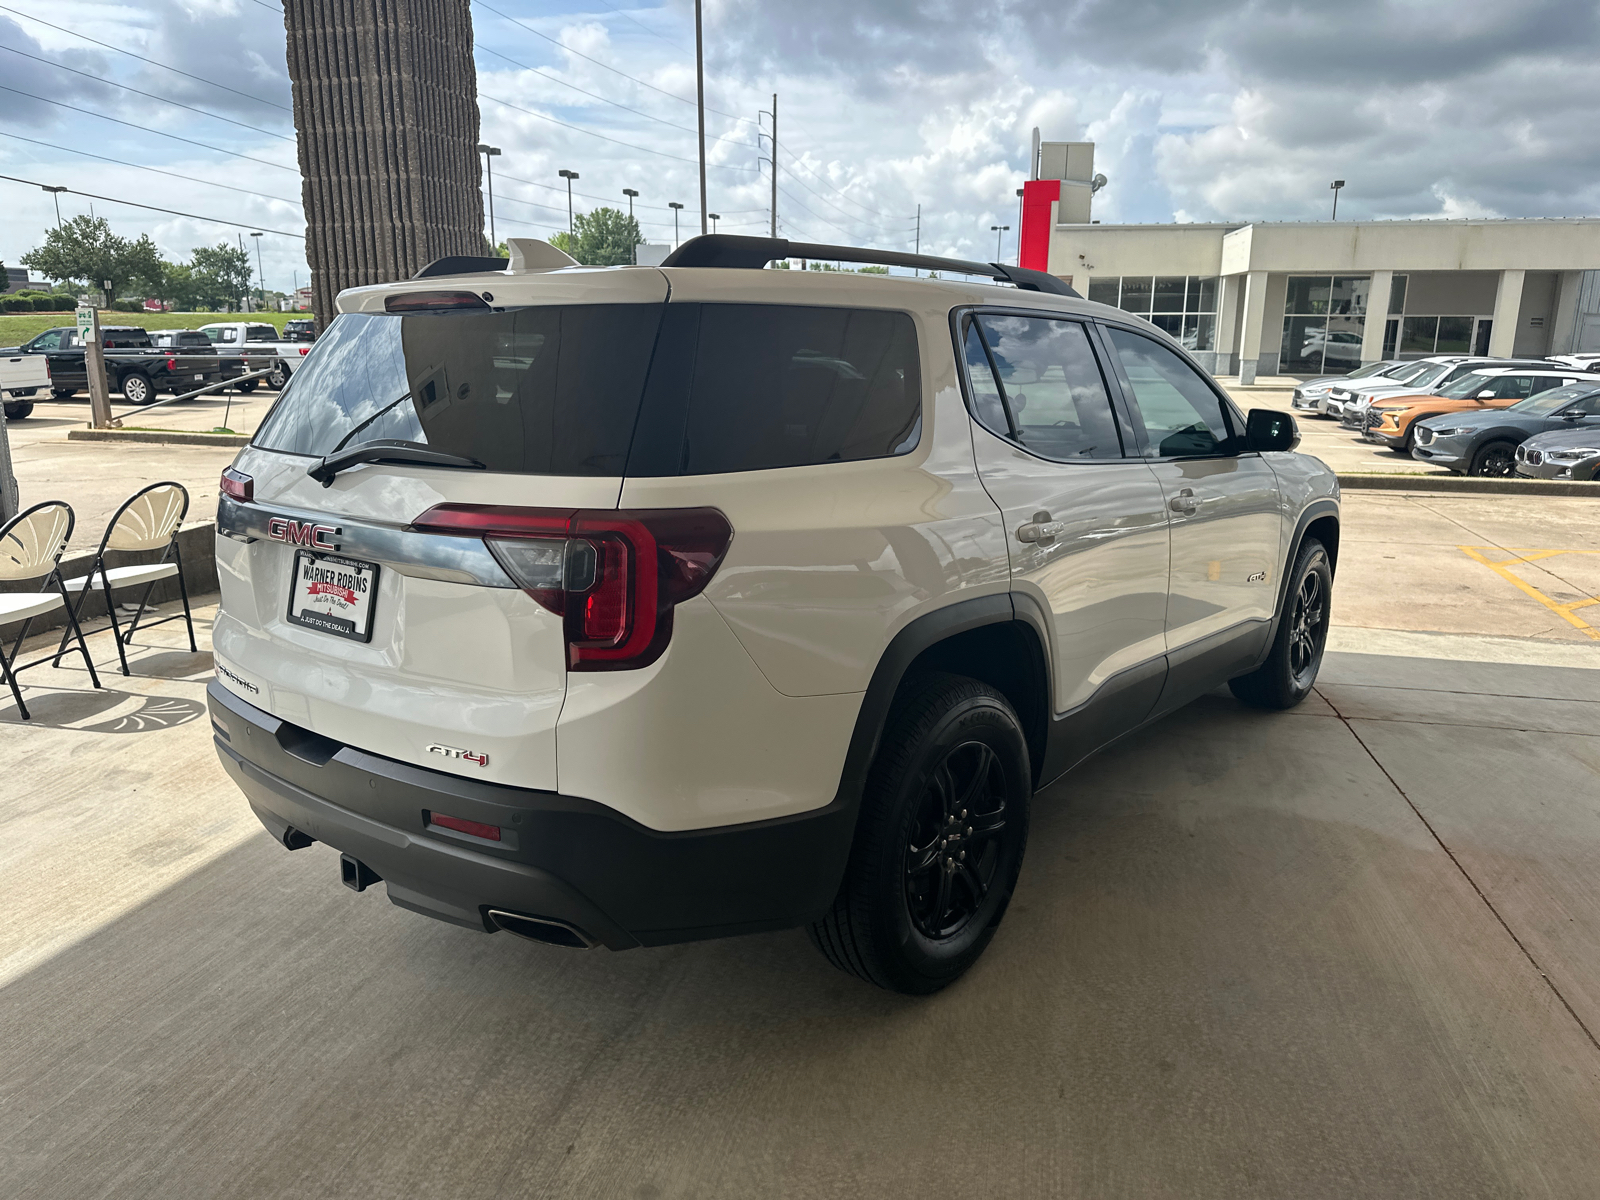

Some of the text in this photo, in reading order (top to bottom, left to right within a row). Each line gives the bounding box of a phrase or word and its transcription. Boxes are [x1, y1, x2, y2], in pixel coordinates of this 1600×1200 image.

[268, 517, 341, 551] GMC
[303, 564, 368, 594] WARNER ROBINS
[316, 583, 349, 599] MITSUBISHI
[304, 616, 316, 625] JUST
[322, 620, 332, 629] THE
[331, 623, 346, 633] DEAL!
[425, 742, 490, 768] AT4
